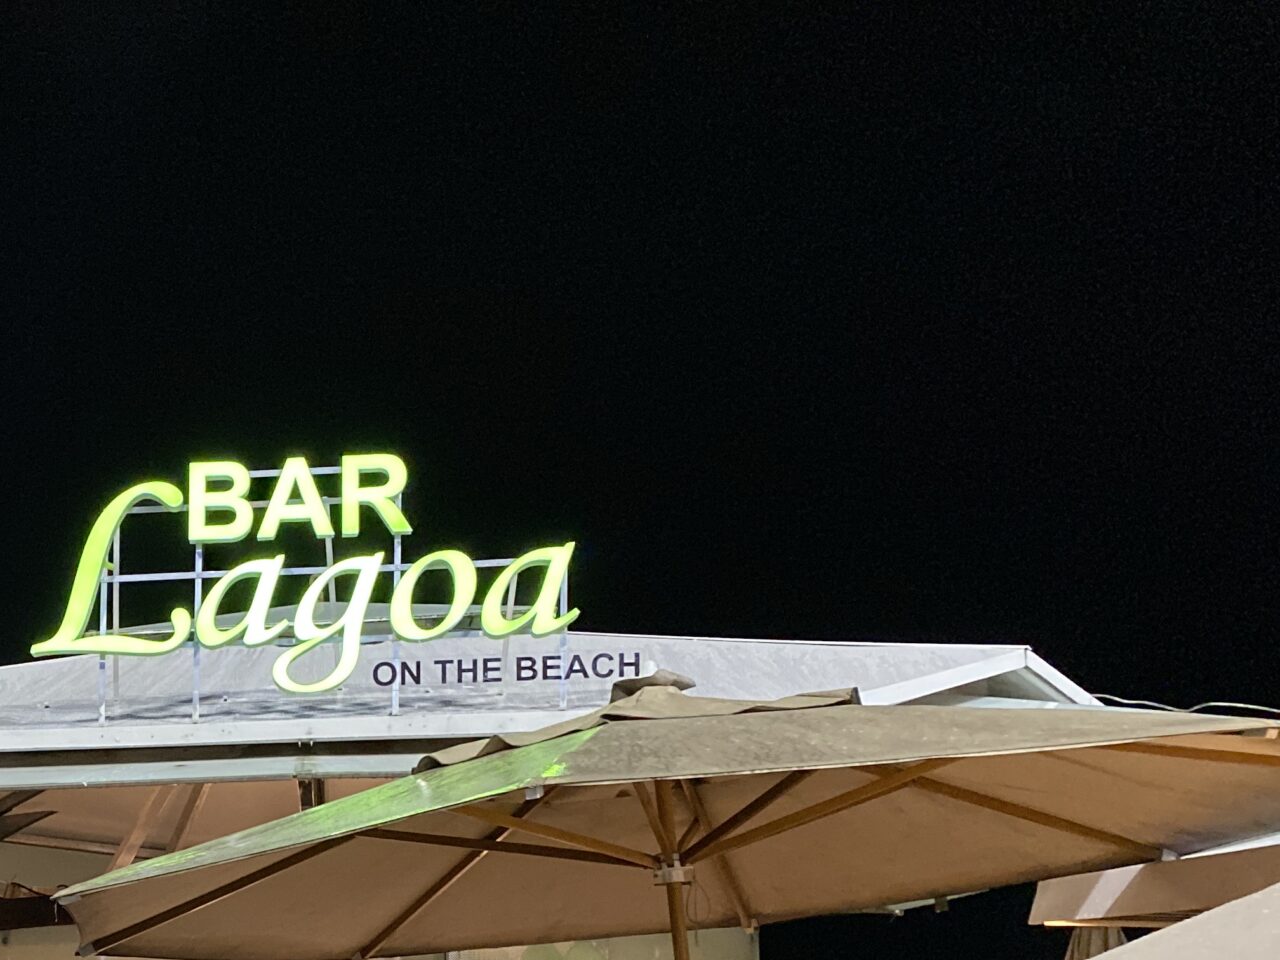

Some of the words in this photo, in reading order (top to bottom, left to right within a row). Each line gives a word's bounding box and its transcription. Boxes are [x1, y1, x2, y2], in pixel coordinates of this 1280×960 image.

[189, 453, 413, 544] BAR
[30, 481, 580, 693] Lagoa
[373, 660, 421, 687] ON
[434, 657, 503, 684] THE
[516, 652, 641, 681] BEACH
